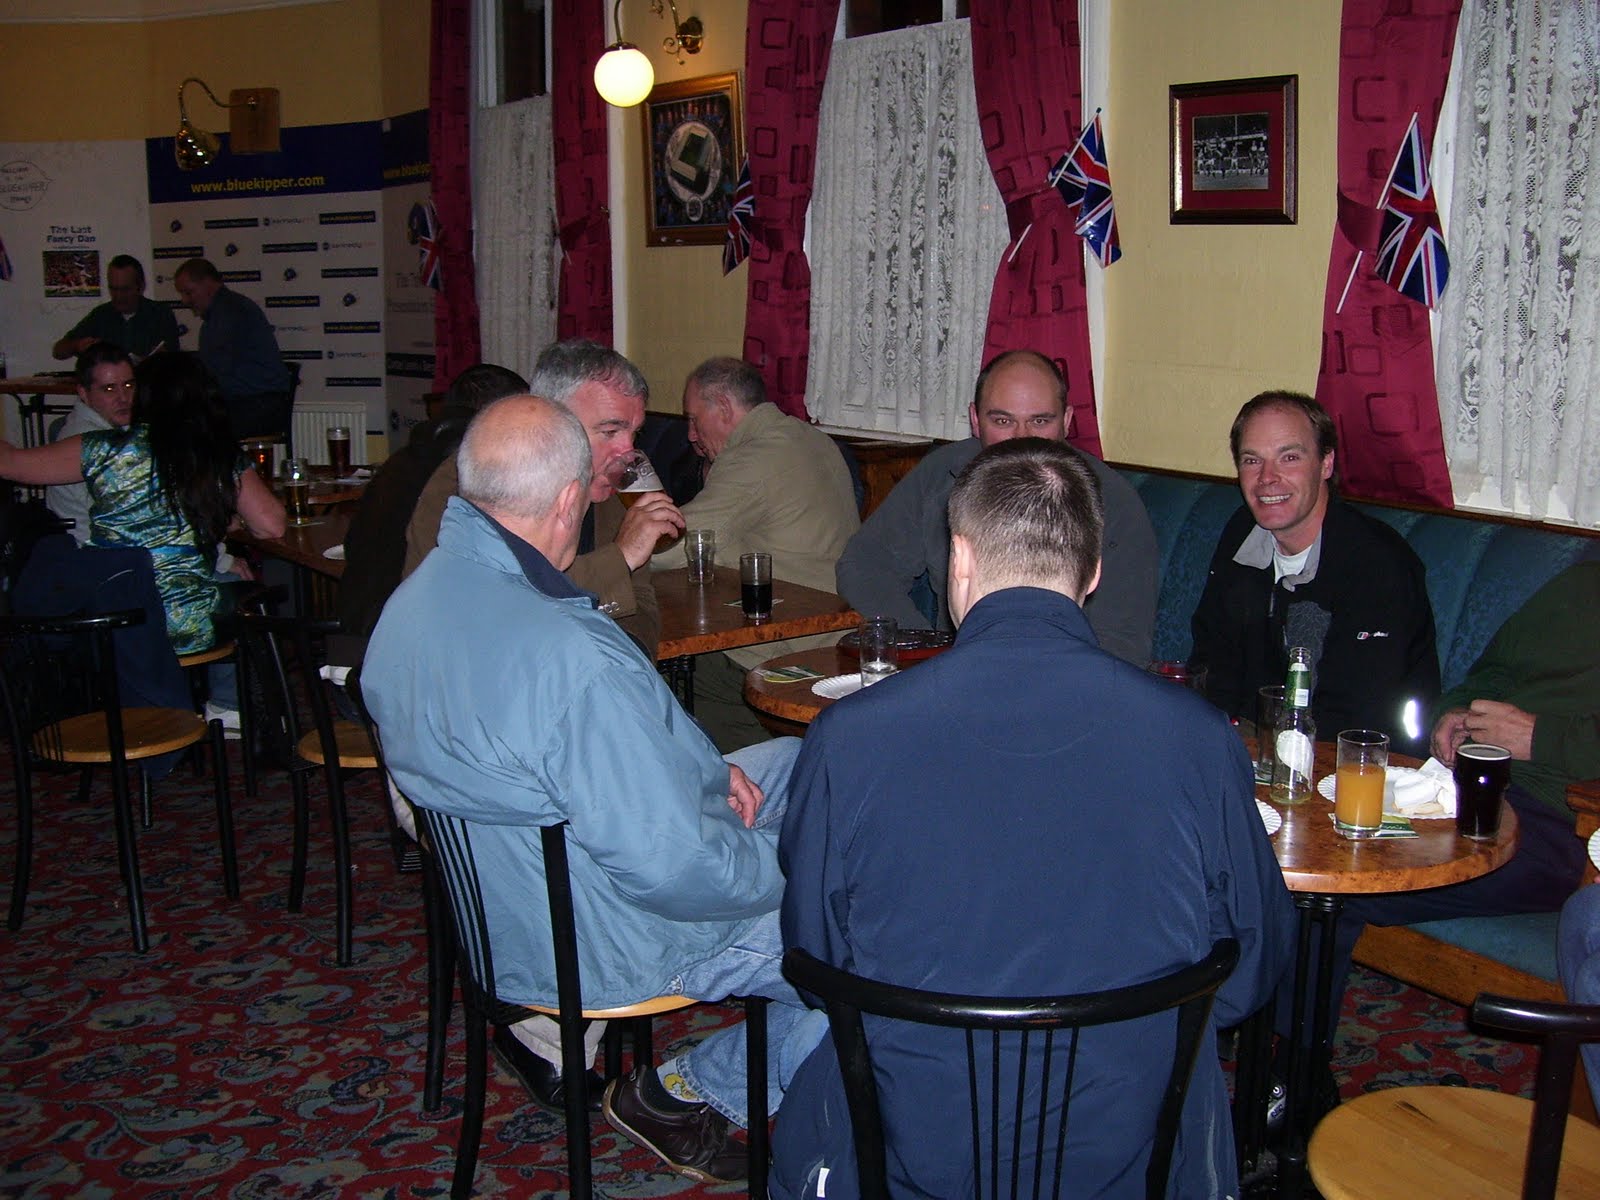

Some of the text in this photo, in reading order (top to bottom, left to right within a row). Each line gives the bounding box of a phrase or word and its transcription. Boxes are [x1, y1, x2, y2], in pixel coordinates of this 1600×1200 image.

[190, 175, 325, 193] www.bluekipper.com
[49, 225, 92, 234] The Last
[47, 235, 96, 245] Fancy Dan
